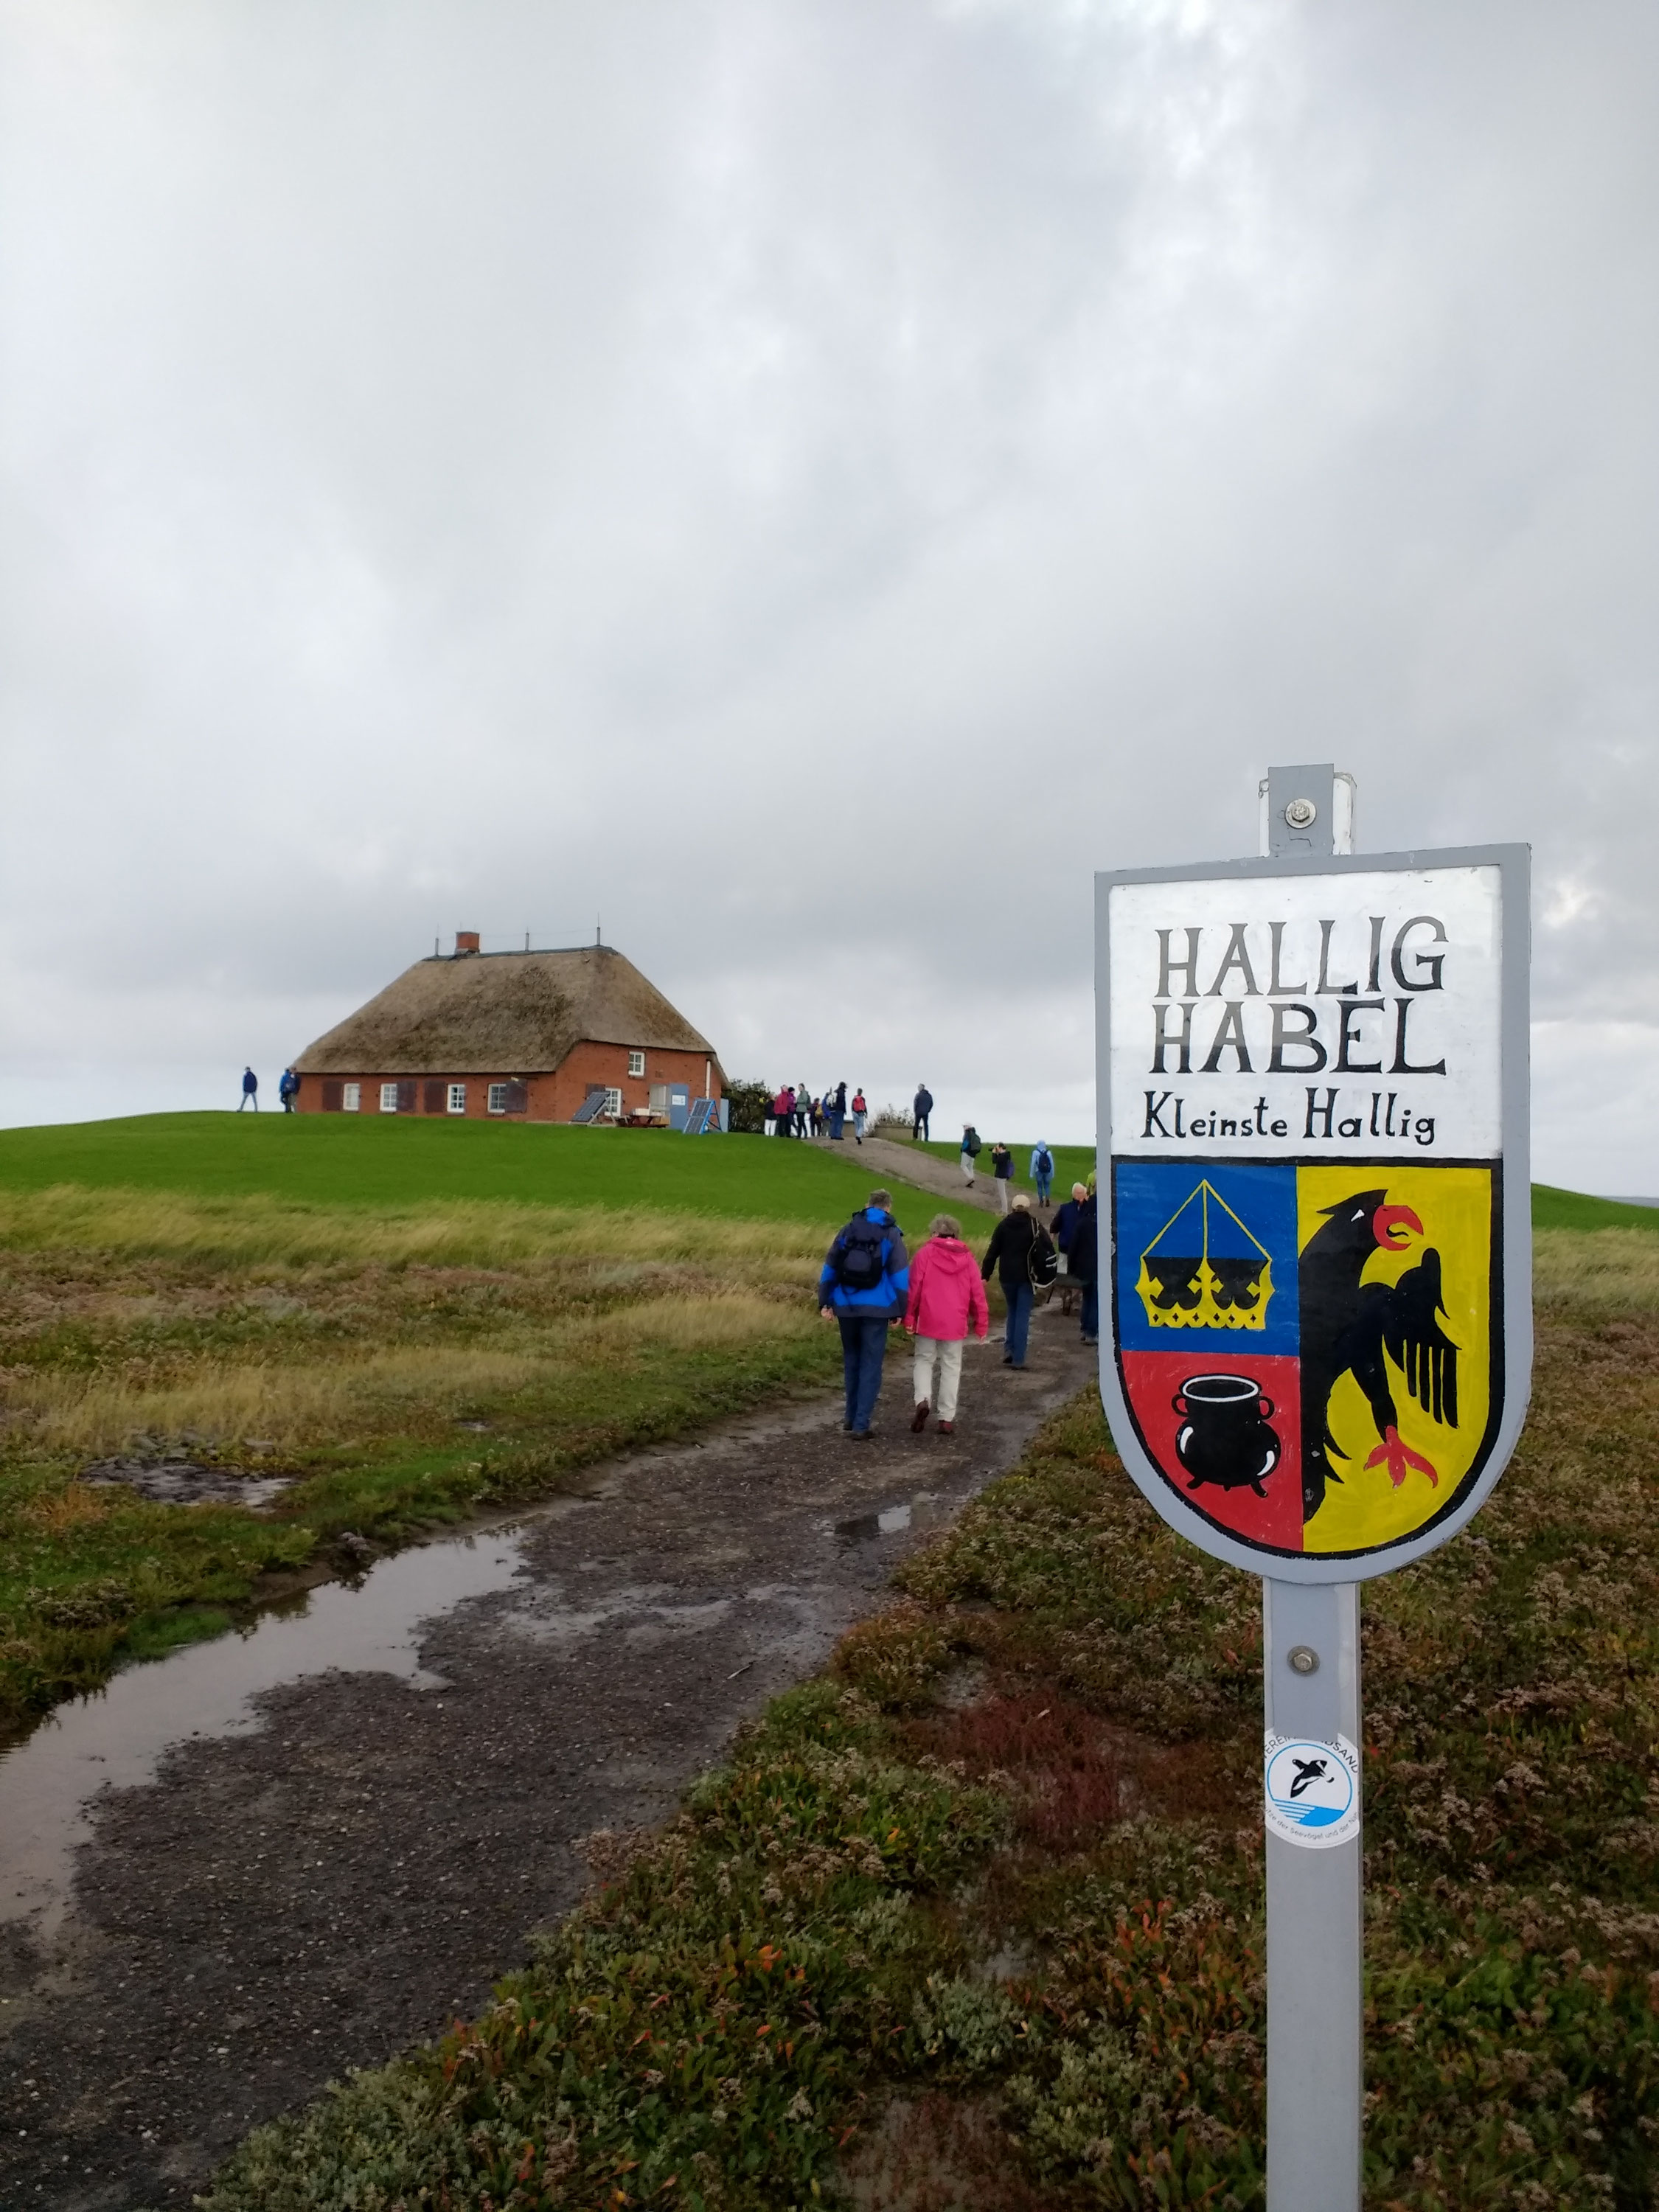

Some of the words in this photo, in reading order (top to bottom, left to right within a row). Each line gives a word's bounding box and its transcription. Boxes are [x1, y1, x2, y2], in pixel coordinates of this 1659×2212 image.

[1155, 916, 1449, 998] HALLIG
[1149, 998, 1447, 1075] HABEL
[1140, 1091, 1288, 1138] Kleinste
[1302, 1087, 1436, 1146] Hallig
